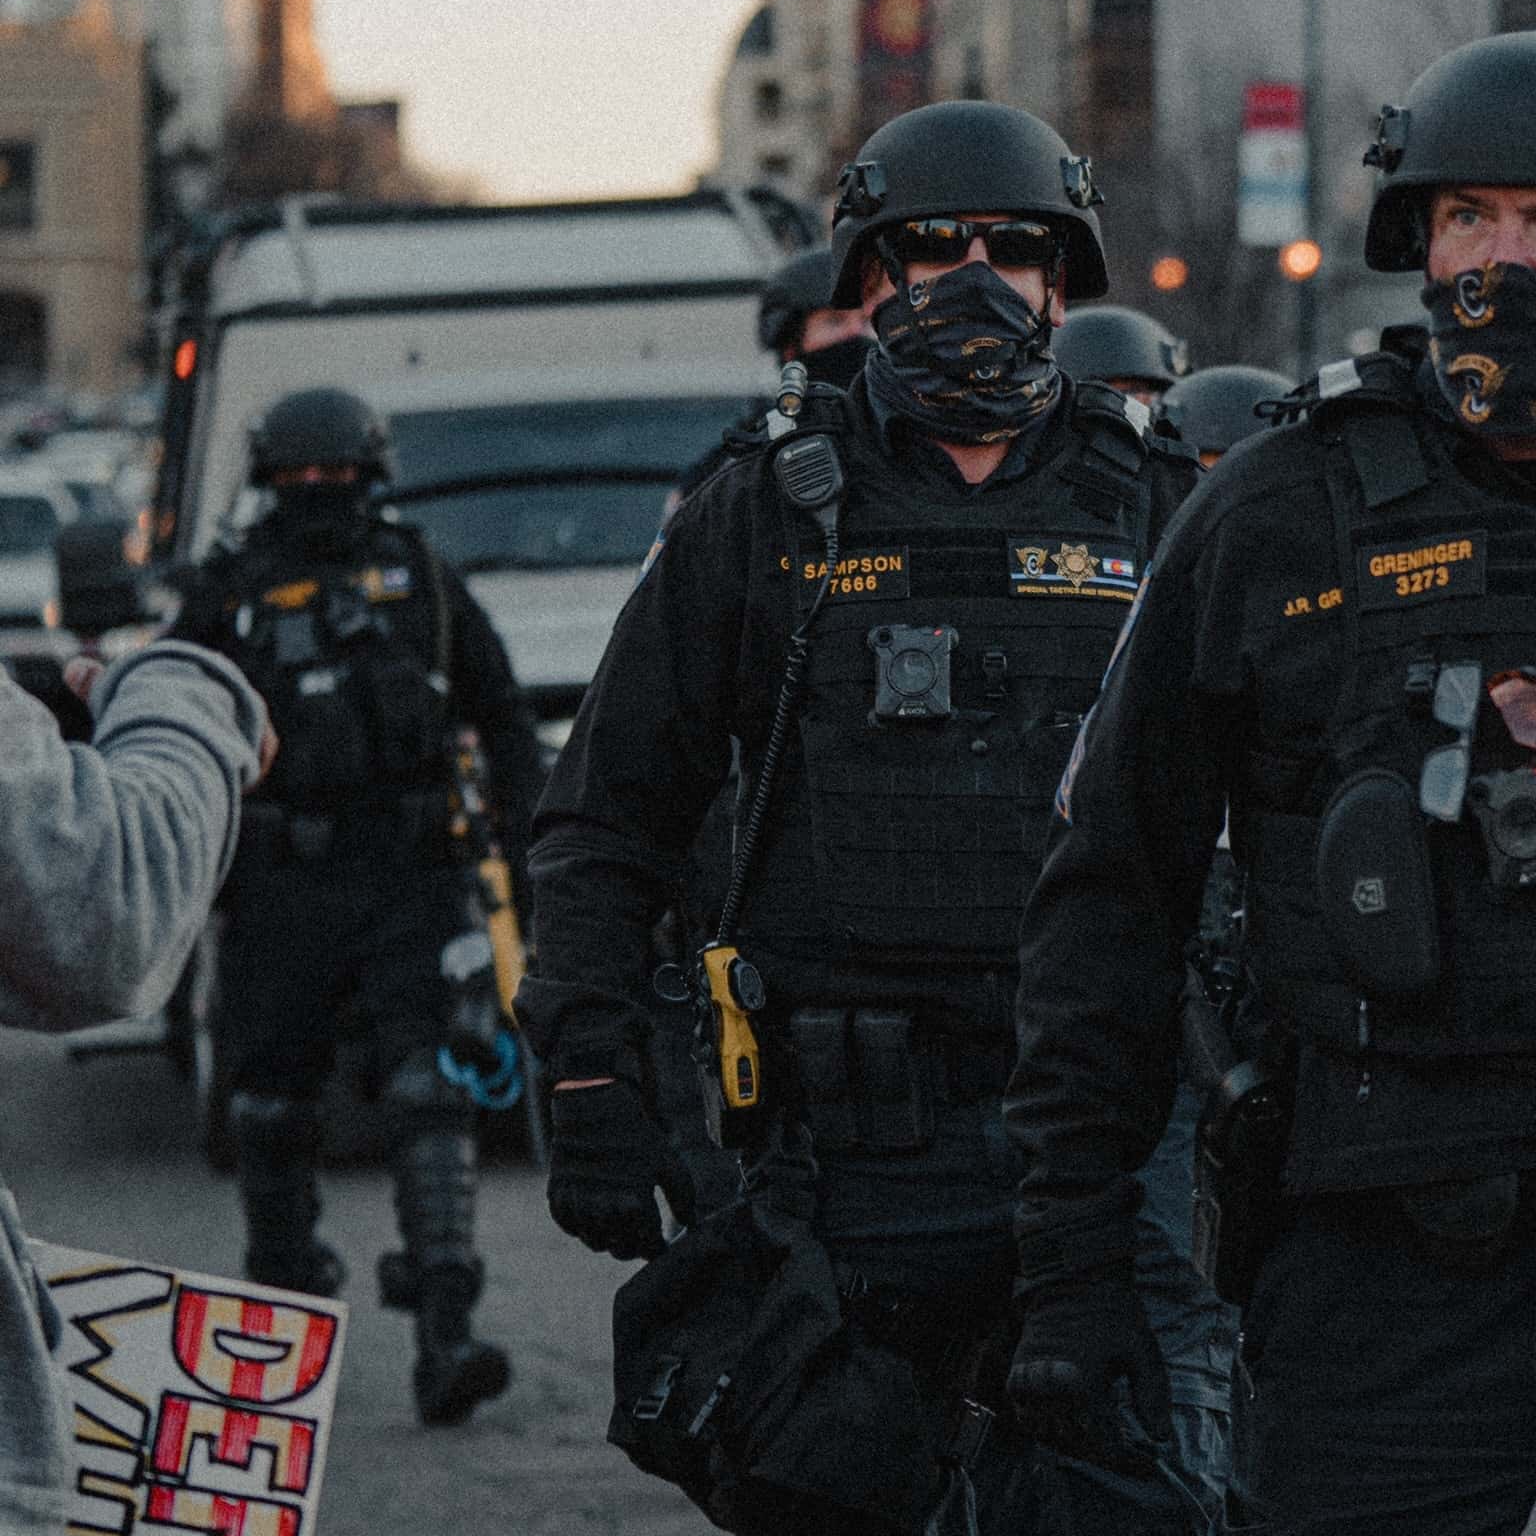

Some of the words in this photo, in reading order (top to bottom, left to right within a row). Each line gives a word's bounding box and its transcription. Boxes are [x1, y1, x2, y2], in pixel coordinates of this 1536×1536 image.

[804, 555, 902, 580] SAMPSON
[1369, 539, 1473, 577] GRENINGER
[830, 575, 877, 595] 7666
[1395, 566, 1449, 596] 3273
